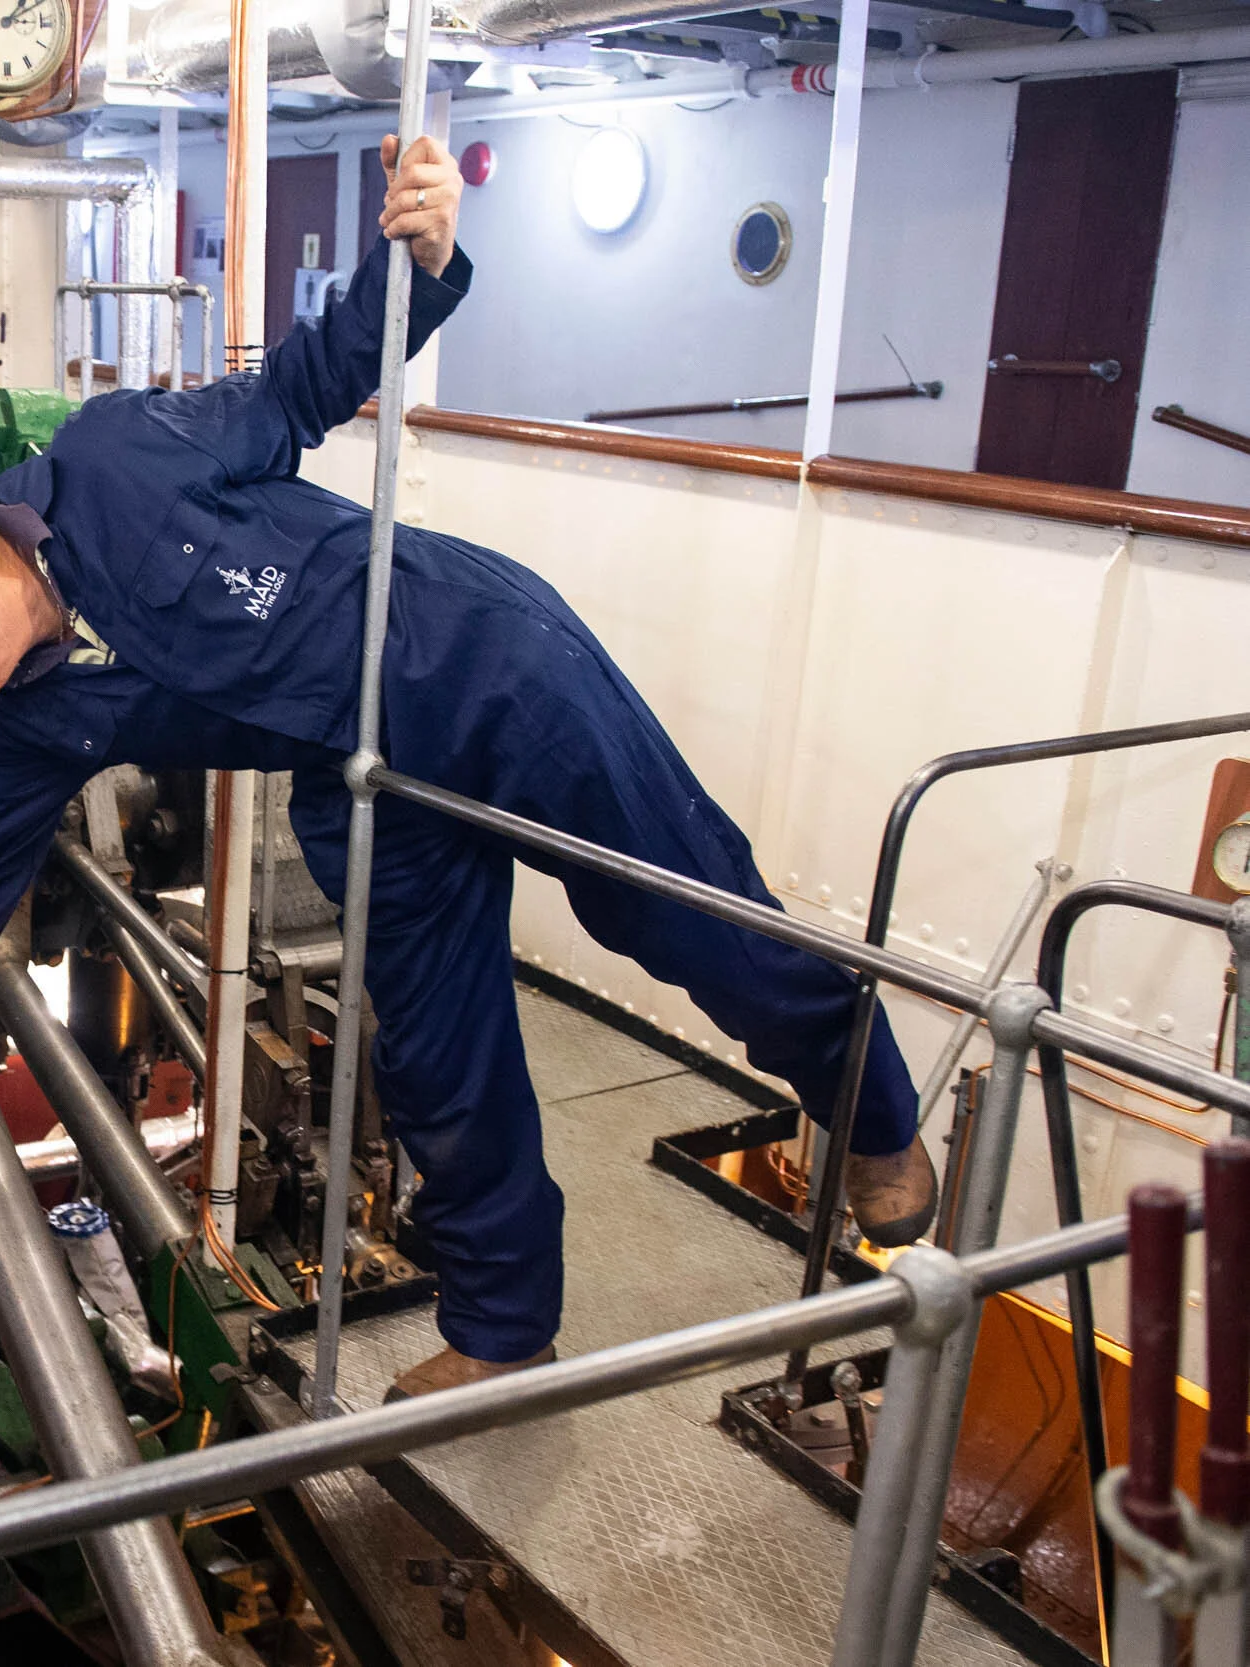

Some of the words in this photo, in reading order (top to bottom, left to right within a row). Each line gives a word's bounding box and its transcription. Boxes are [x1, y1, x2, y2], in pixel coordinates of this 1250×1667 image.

[244, 566, 278, 617] MAID
[260, 609, 269, 620] OF
[265, 593, 277, 607] THE
[272, 571, 287, 594] LOCH
